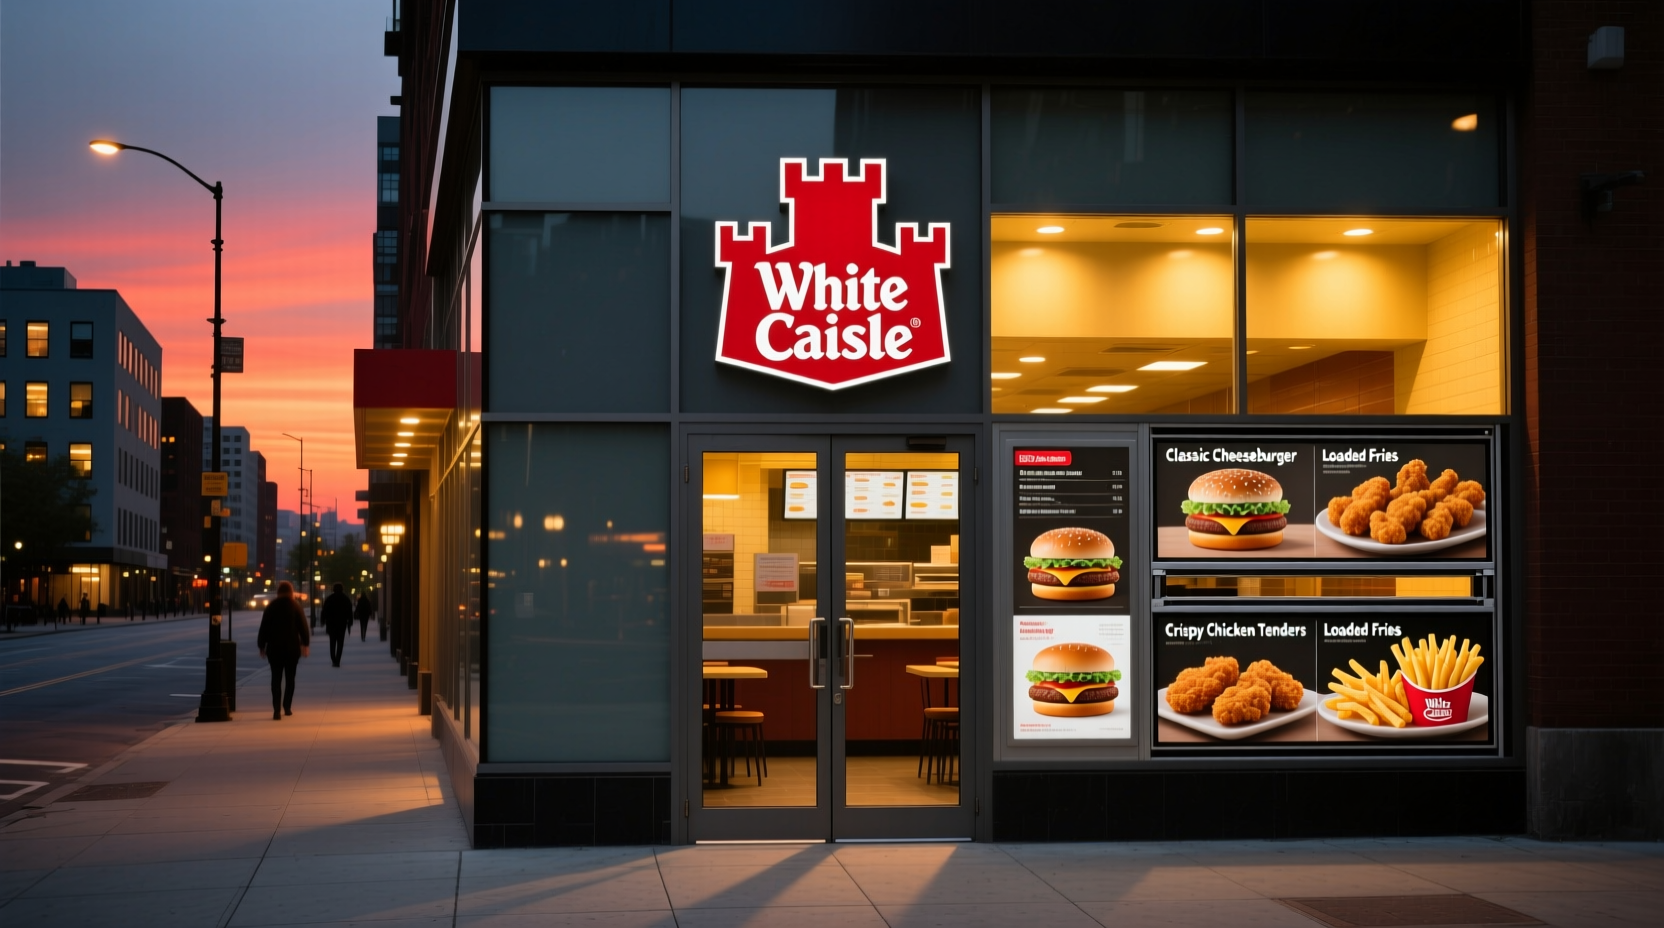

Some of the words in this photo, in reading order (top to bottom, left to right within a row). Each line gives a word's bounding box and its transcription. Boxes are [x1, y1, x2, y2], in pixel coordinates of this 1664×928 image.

[754, 261, 908, 311] White
[1165, 447, 1211, 462] Classic
[1212, 447, 1297, 466] Cheeseburger
[1322, 447, 1367, 462] Loaded
[1369, 447, 1399, 462] Fries
[1165, 622, 1204, 641] Crispy
[1206, 622, 1256, 637] Chicken
[1257, 622, 1307, 637] Tenders
